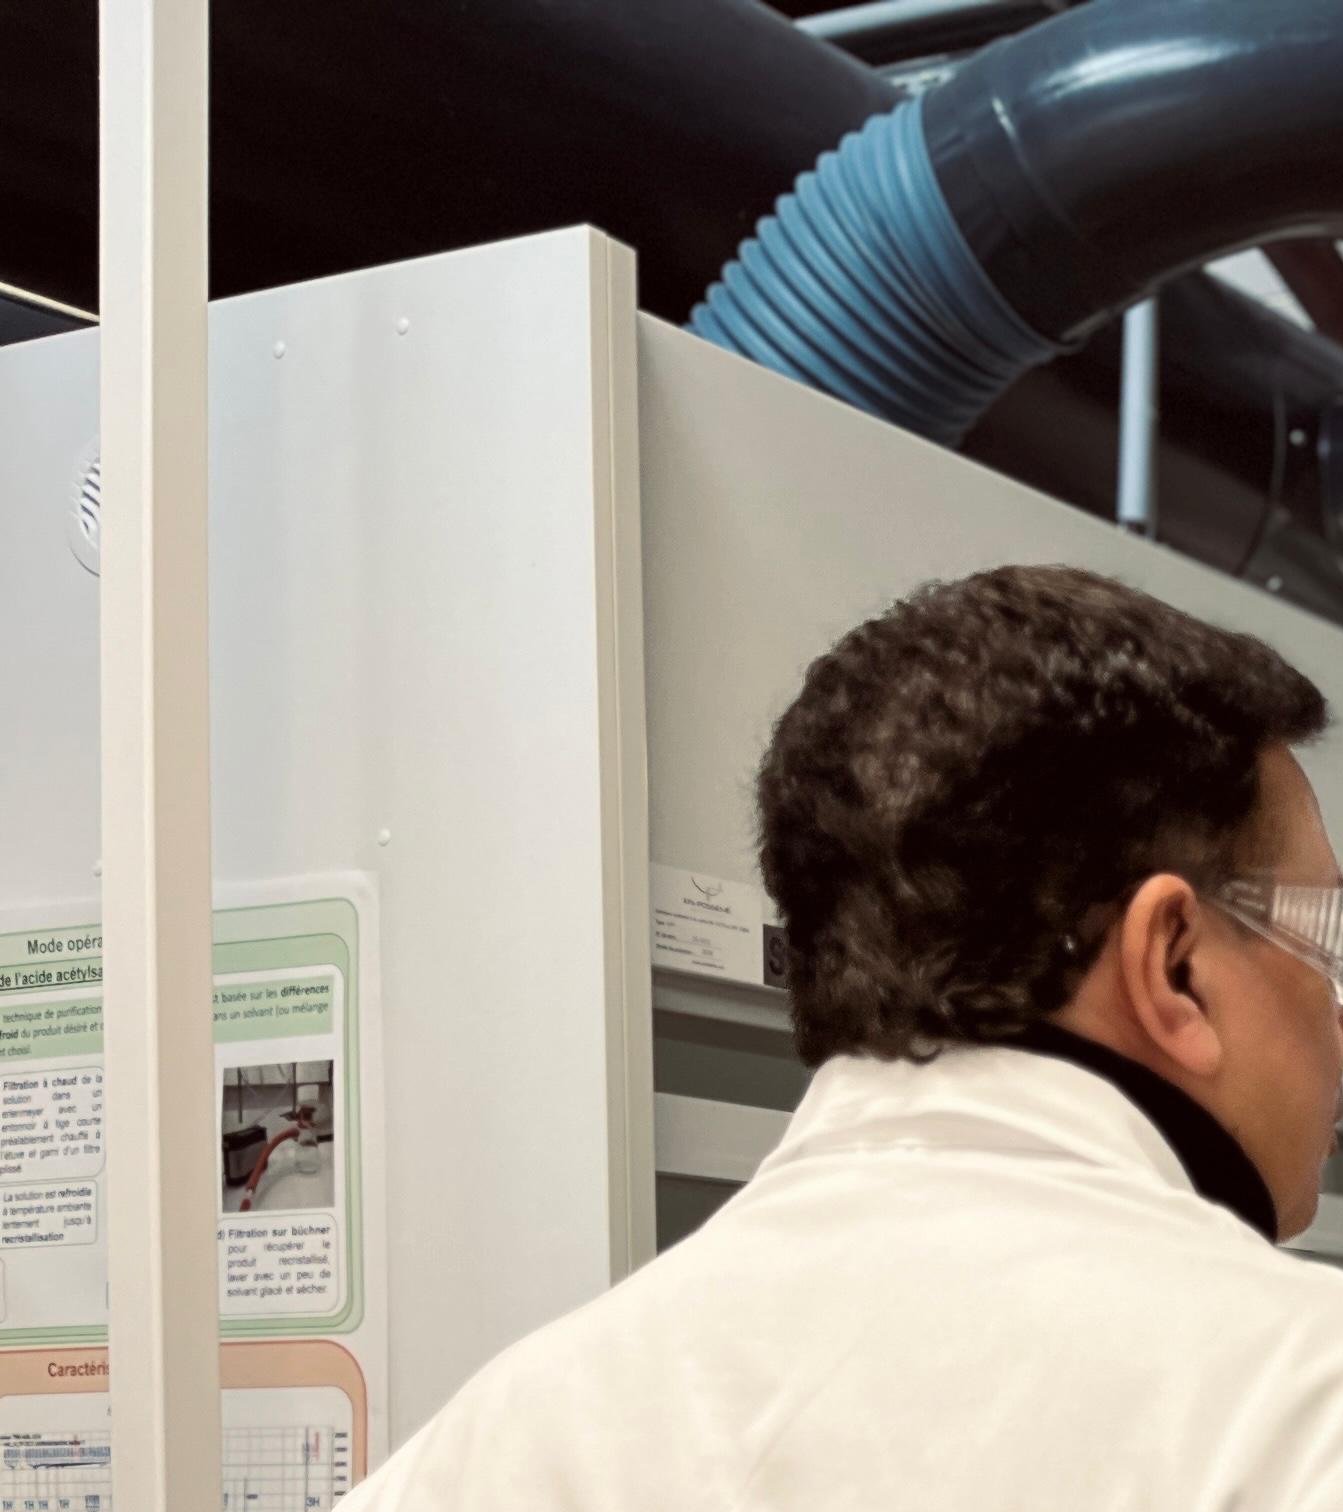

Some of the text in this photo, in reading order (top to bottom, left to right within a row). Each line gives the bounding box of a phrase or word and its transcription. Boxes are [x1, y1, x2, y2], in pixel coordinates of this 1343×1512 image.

[27, 938, 63, 955] Mode
[15, 970, 52, 985] l'acide
[281, 985, 329, 998] différences
[52, 1076, 77, 1086] chaud
[272, 1228, 288, 1237] sur
